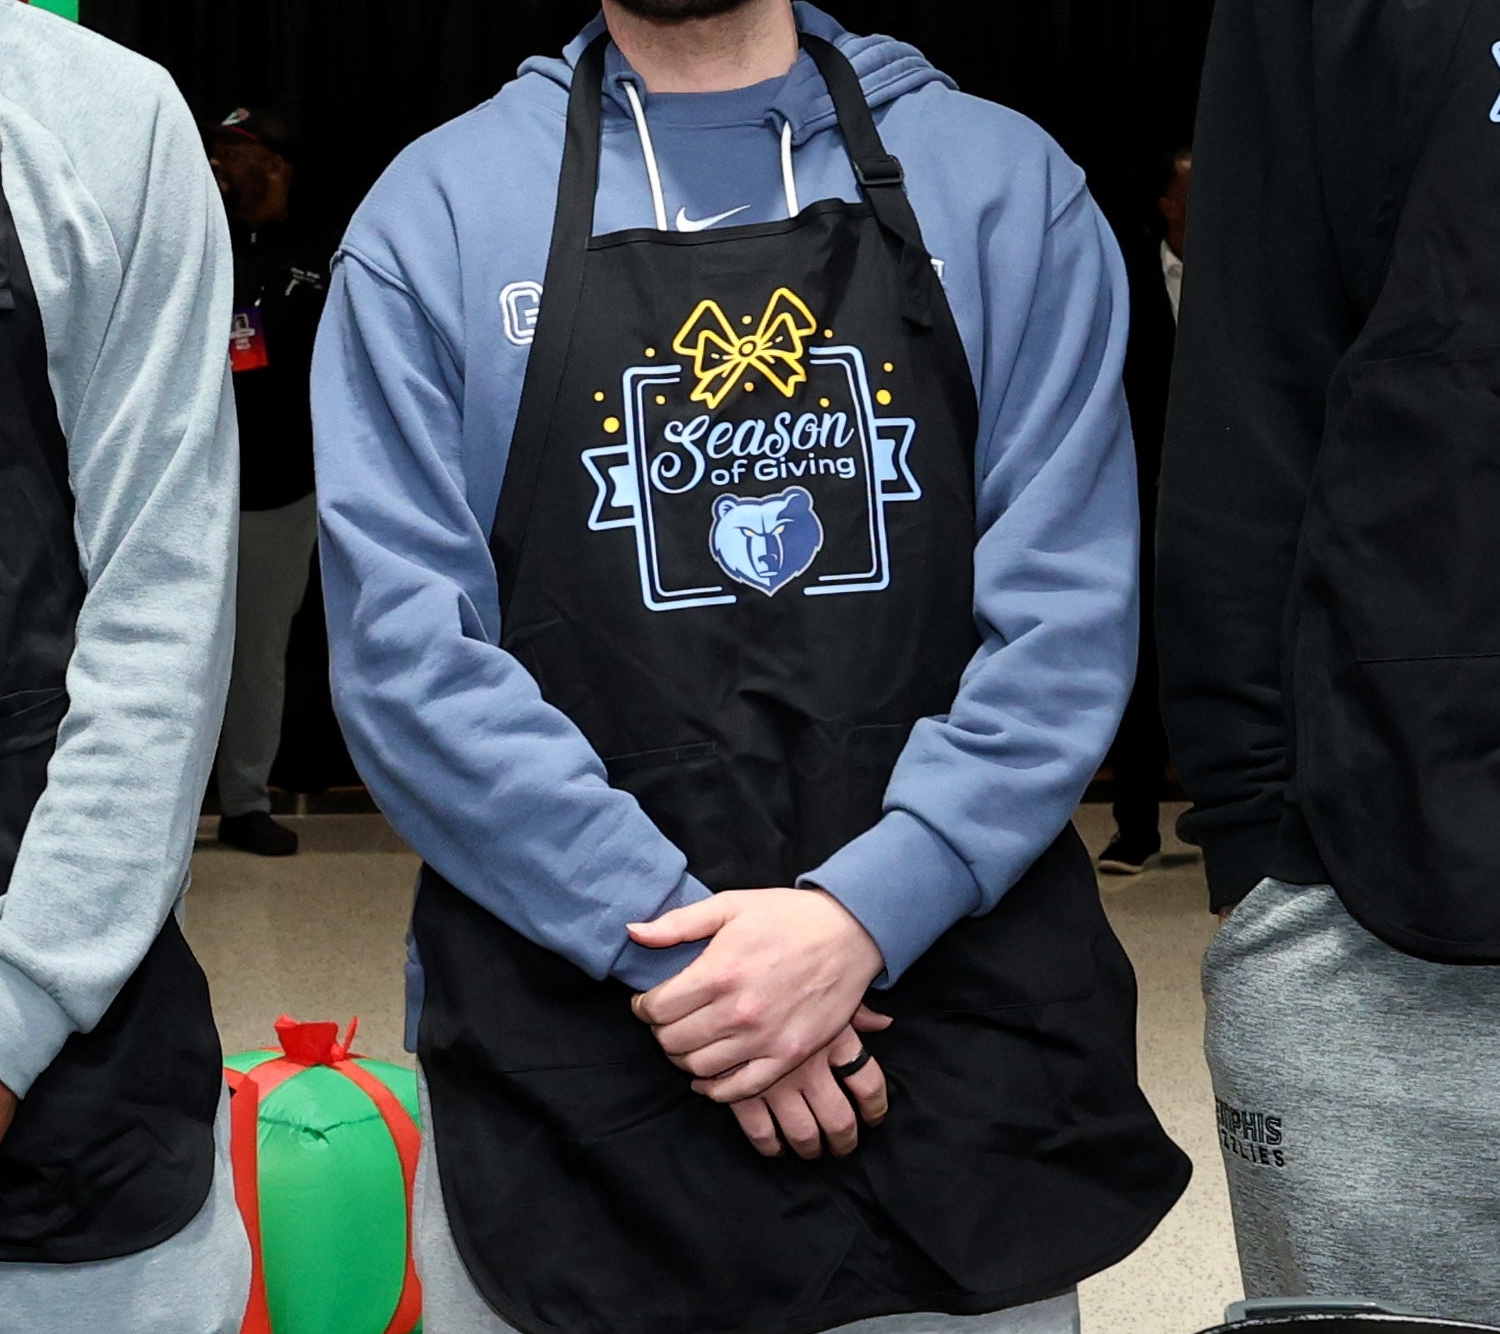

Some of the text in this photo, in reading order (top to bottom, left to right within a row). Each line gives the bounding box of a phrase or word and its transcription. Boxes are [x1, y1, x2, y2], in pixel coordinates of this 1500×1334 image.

[650, 411, 855, 494] Season
[710, 455, 856, 486] of Giving
